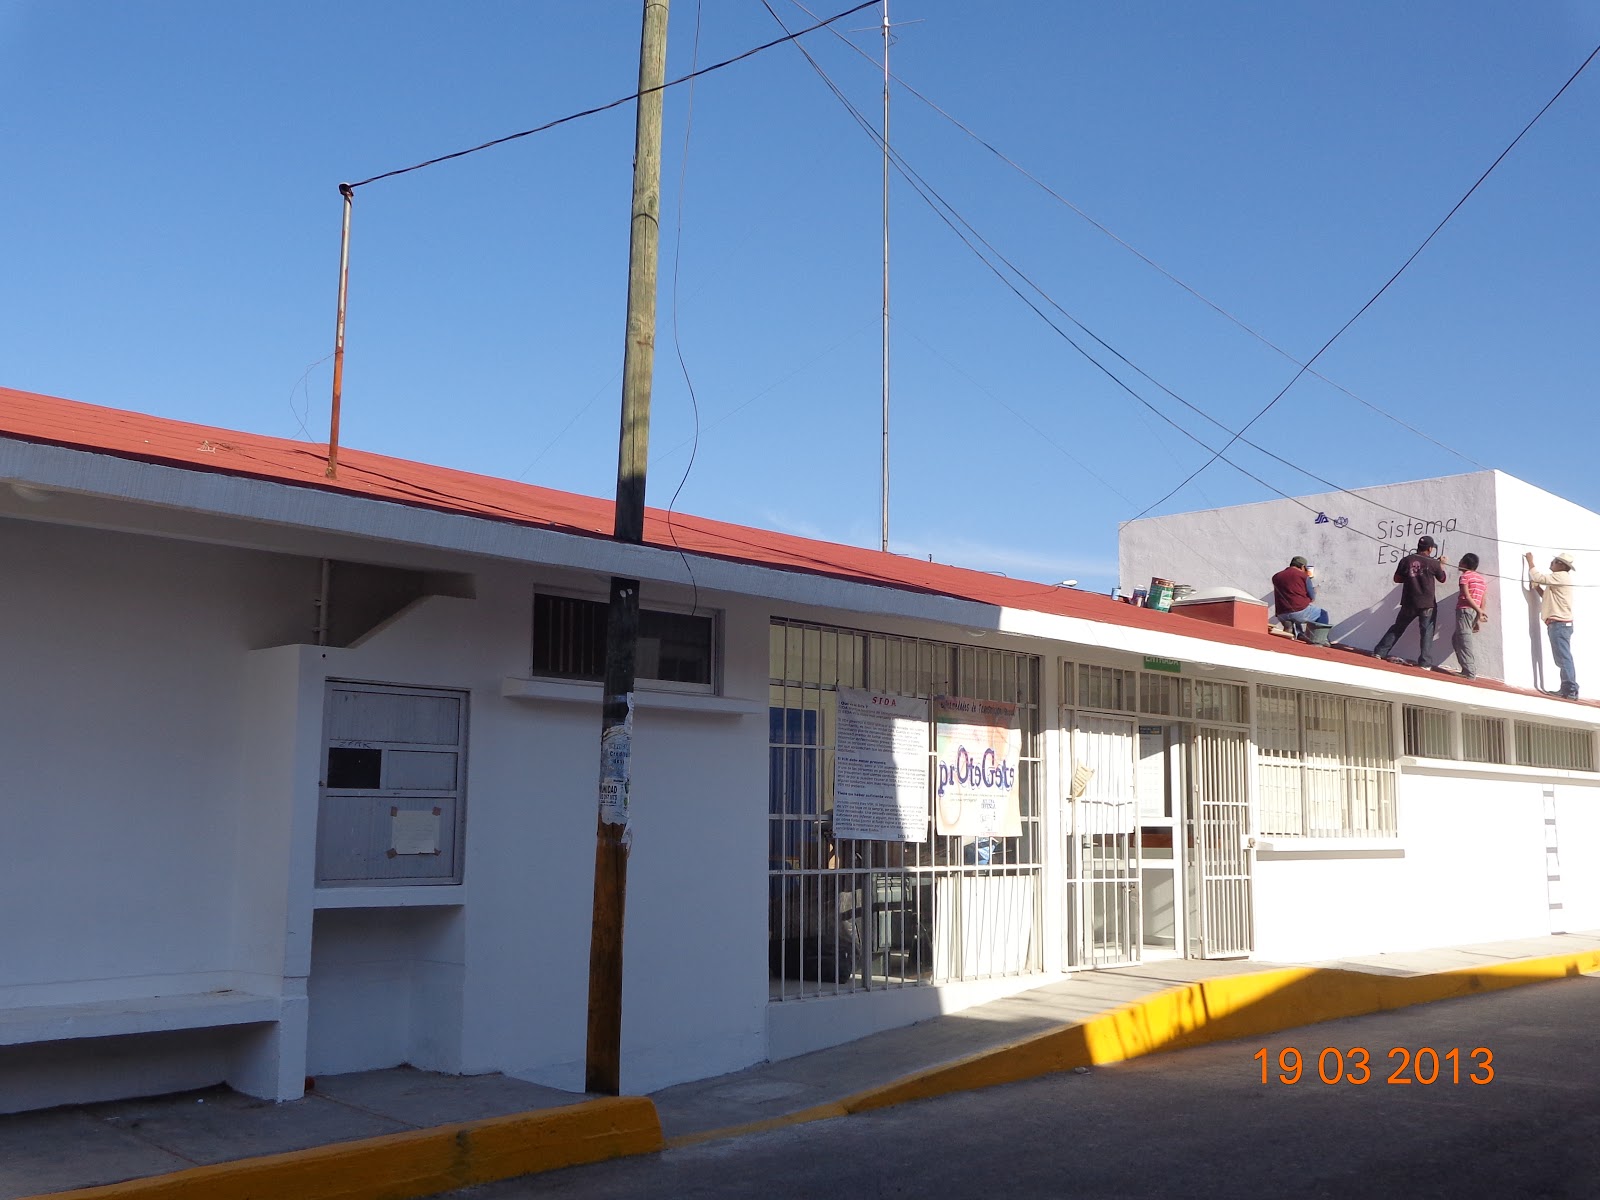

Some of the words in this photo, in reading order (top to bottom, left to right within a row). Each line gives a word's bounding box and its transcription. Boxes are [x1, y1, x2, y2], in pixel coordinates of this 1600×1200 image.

[1377, 517, 1457, 540] Sistema
[1377, 539, 1446, 565] Estal
[872, 696, 897, 707] SIDA
